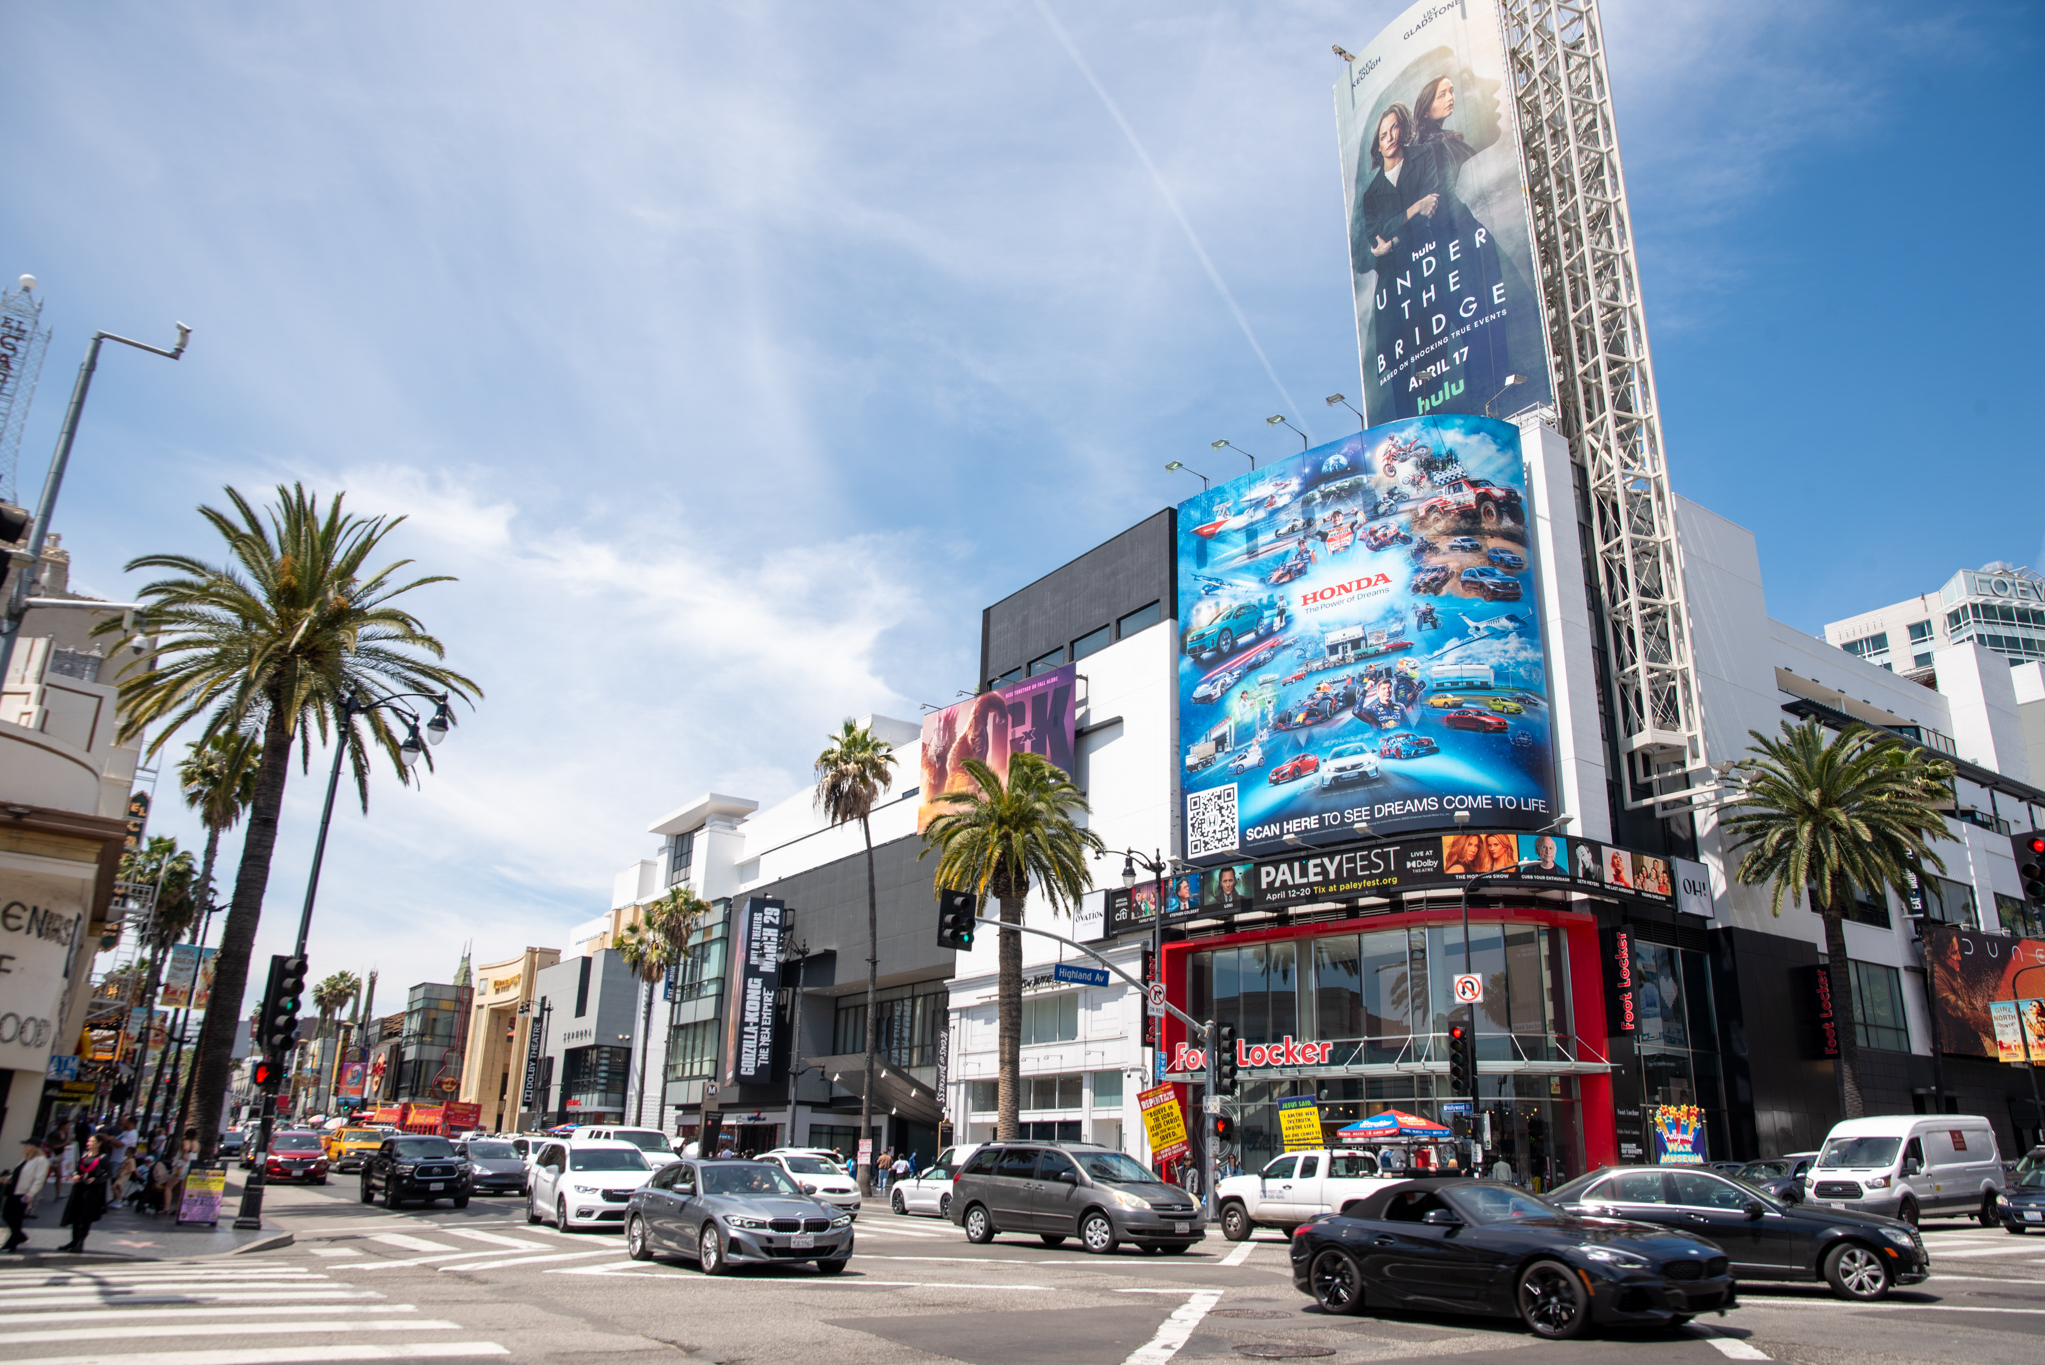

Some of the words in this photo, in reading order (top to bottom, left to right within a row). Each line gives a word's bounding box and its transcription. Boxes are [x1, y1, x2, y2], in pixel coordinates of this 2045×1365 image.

[1403, 0, 1461, 40] GLADSTONE
[1423, 5, 1437, 18] LILY
[1352, 56, 1381, 88] KEOUGH
[1411, 241, 1436, 262] hulu
[1376, 228, 1486, 310] UNDER
[1401, 269, 1461, 319] THE
[1377, 282, 1506, 374] BRIDGE
[1380, 368, 1398, 386] BASED
[1399, 360, 1409, 371] ON
[1410, 336, 1449, 363] SHOCKING
[1451, 324, 1471, 339] TRUE
[1474, 308, 1507, 328] EVENTS
[1453, 346, 1469, 365] 17
[1417, 378, 1465, 415] hulu
[1301, 573, 1392, 606] HONDA
[1305, 606, 1320, 615] The
[1320, 599, 1345, 610] Power
[1346, 595, 1355, 603] of
[1357, 587, 1390, 600] Dreams
[1014, 685, 1031, 696] TOGETHER
[1246, 824, 1280, 841] SCAN
[1283, 815, 1320, 834] HERE
[1322, 811, 1341, 826] TO
[1344, 806, 1371, 823] SEE
[1374, 797, 1439, 818] DREAMS
[1443, 795, 1493, 809] COME
[1495, 795, 1517, 810] TO
[1520, 797, 1550, 814] LIFE.
[1411, 850, 1423, 858] LIVE
[1416, 859, 1439, 869] Dolby
[1260, 846, 1400, 890] PALEYFEST
[1266, 889, 1286, 901] April
[1288, 887, 1311, 899] 12-20
[1313, 885, 1326, 895] Tix
[1328, 884, 1337, 892] at
[1339, 876, 1398, 892] paleyfest.org
[1587, 880, 1600, 888] MEYERS
[1683, 878, 1707, 897] OH!
[1910, 896, 1922, 910] EAT
[763, 907, 781, 925] 29
[1075, 909, 1103, 923] OVATION
[1115, 908, 1128, 922] citi
[752, 912, 763, 941] THEATERS
[751, 941, 761, 949] IN
[1614, 931, 1631, 988] Locker
[1058, 968, 1092, 981] Highland
[1094, 973, 1105, 983] Av
[1816, 969, 1833, 1018] Locker
[761, 987, 775, 1026] EMPIRE
[1156, 1007, 1164, 1015] RED
[1620, 992, 1635, 1031] Foot
[1994, 1006, 2013, 1014] GIRL
[530, 1021, 541, 1059] THEATRE
[940, 1030, 949, 1057] ICONS
[1822, 1021, 1838, 1055] Foot
[757, 1048, 770, 1068] THE
[1236, 1035, 1334, 1068] Locker
[526, 1061, 536, 1089] DOLBY
[1141, 1094, 1164, 1111] REPENT
[1282, 1101, 1298, 1109] JESUS
[1152, 1116, 1160, 1124] THE
[1161, 1111, 1174, 1120] LORD
[1626, 1109, 1640, 1117] Locker
[1150, 1122, 1163, 1133] JESUS
[1661, 1129, 1695, 1145] Hollywood
[1666, 1141, 1692, 1153] WAX
[1660, 1152, 1704, 1164] MUSEUM
